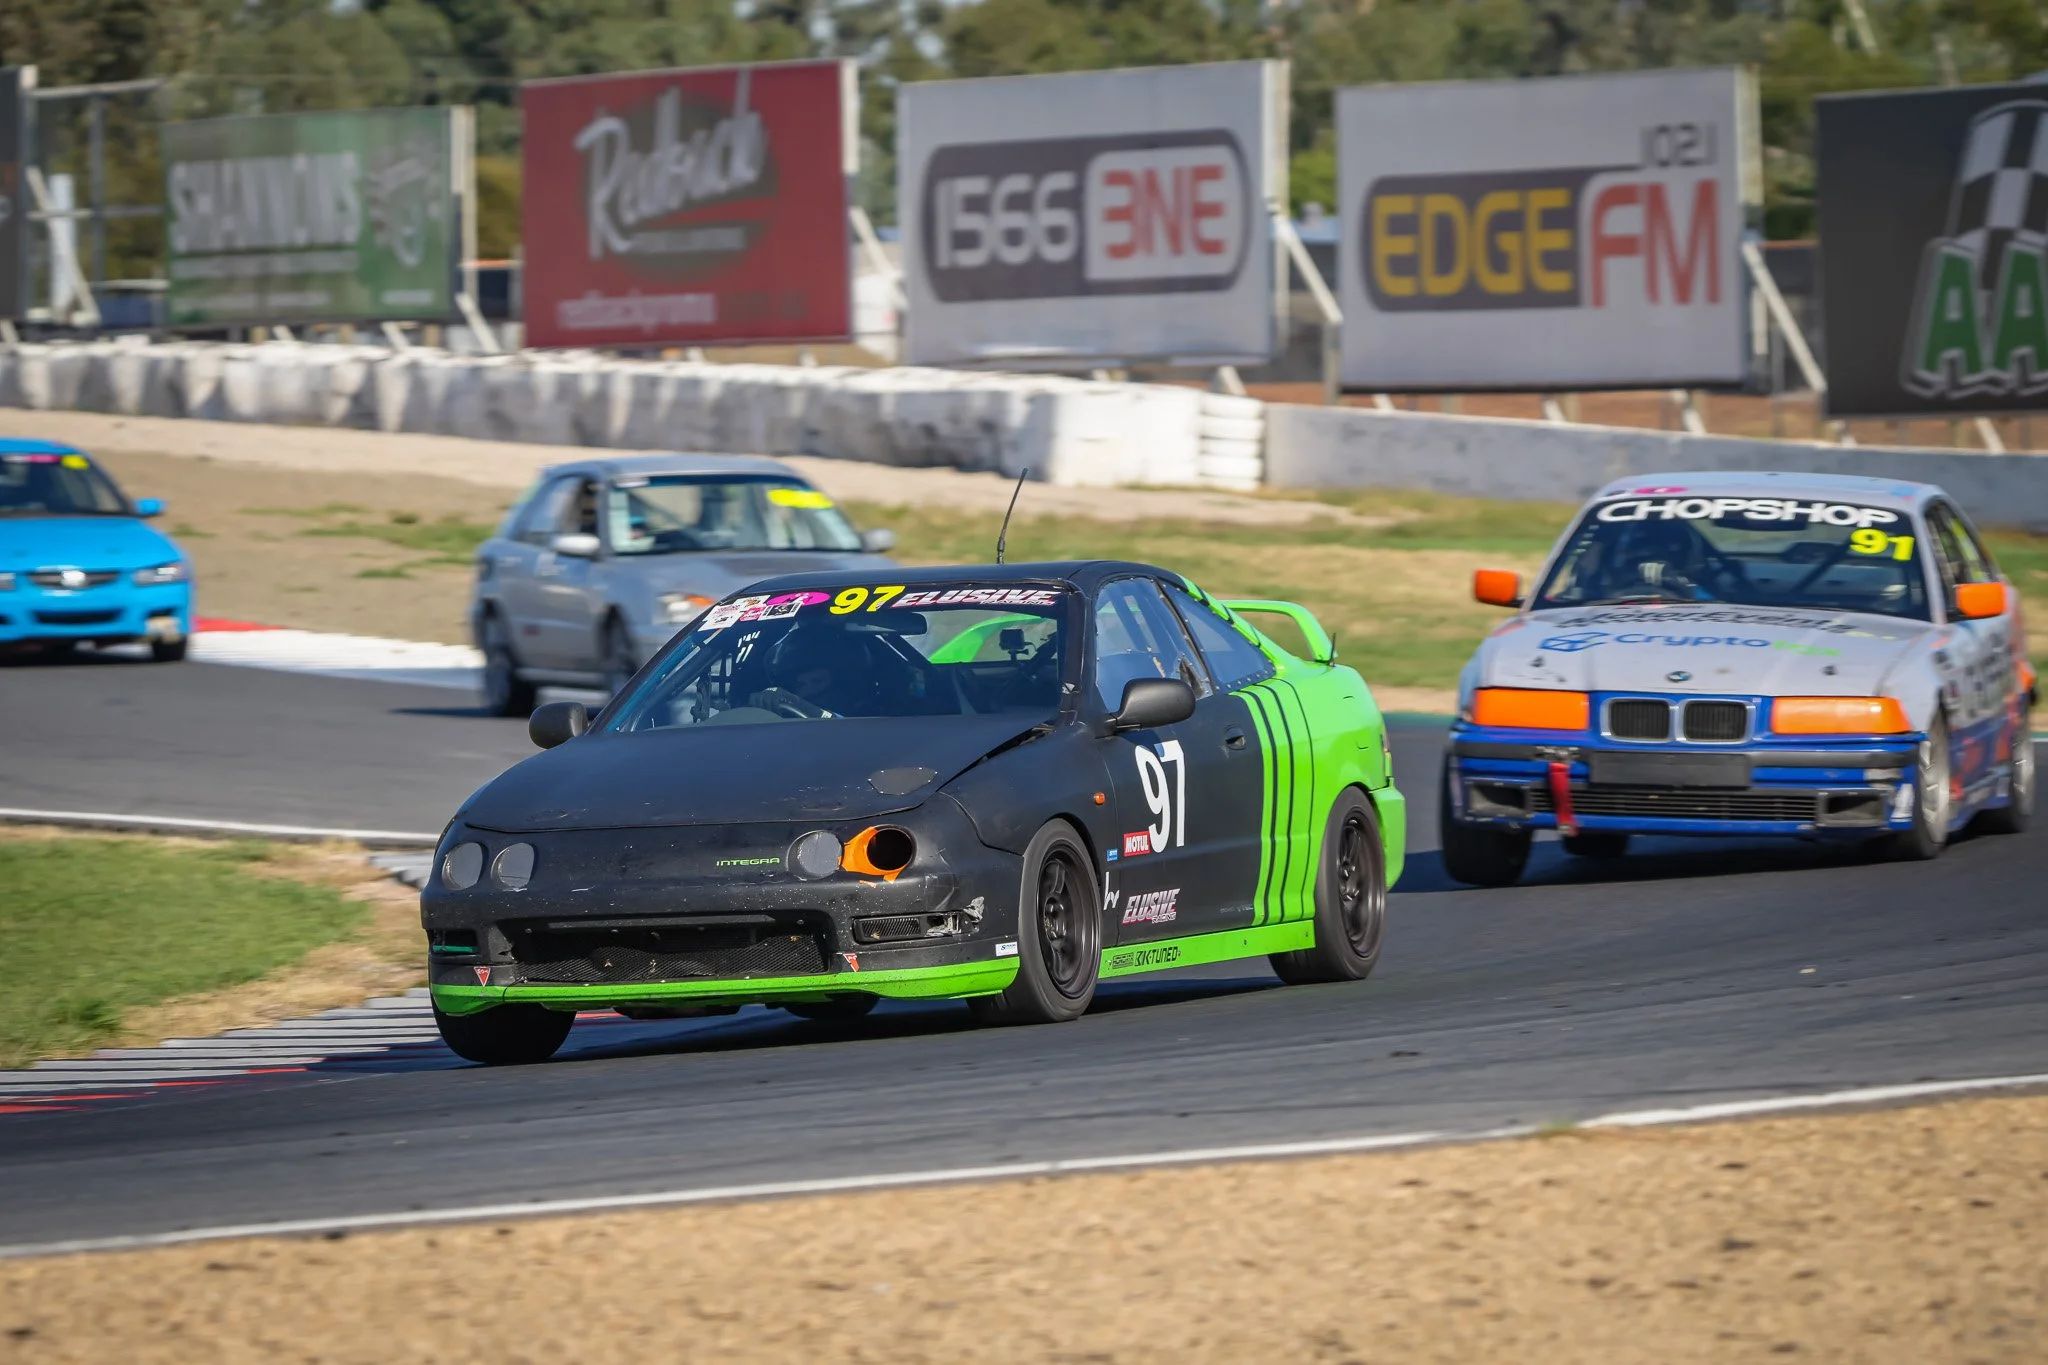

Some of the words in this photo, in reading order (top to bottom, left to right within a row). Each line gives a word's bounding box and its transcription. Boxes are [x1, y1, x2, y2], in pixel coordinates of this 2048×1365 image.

[935, 170, 1078, 269] 1566
[1372, 188, 1575, 297] EDGE
[1589, 178, 1723, 309] FM
[1596, 498, 1899, 527] CHOPSHOP
[1850, 528, 1915, 561] 91
[829, 585, 906, 615] 97
[890, 588, 1062, 608] ELUSIVE
[1134, 739, 1186, 853] 97
[1125, 835, 1149, 853] MOTUL
[716, 857, 780, 867] INTEGRA
[1122, 888, 1181, 924] ELUSIVE
